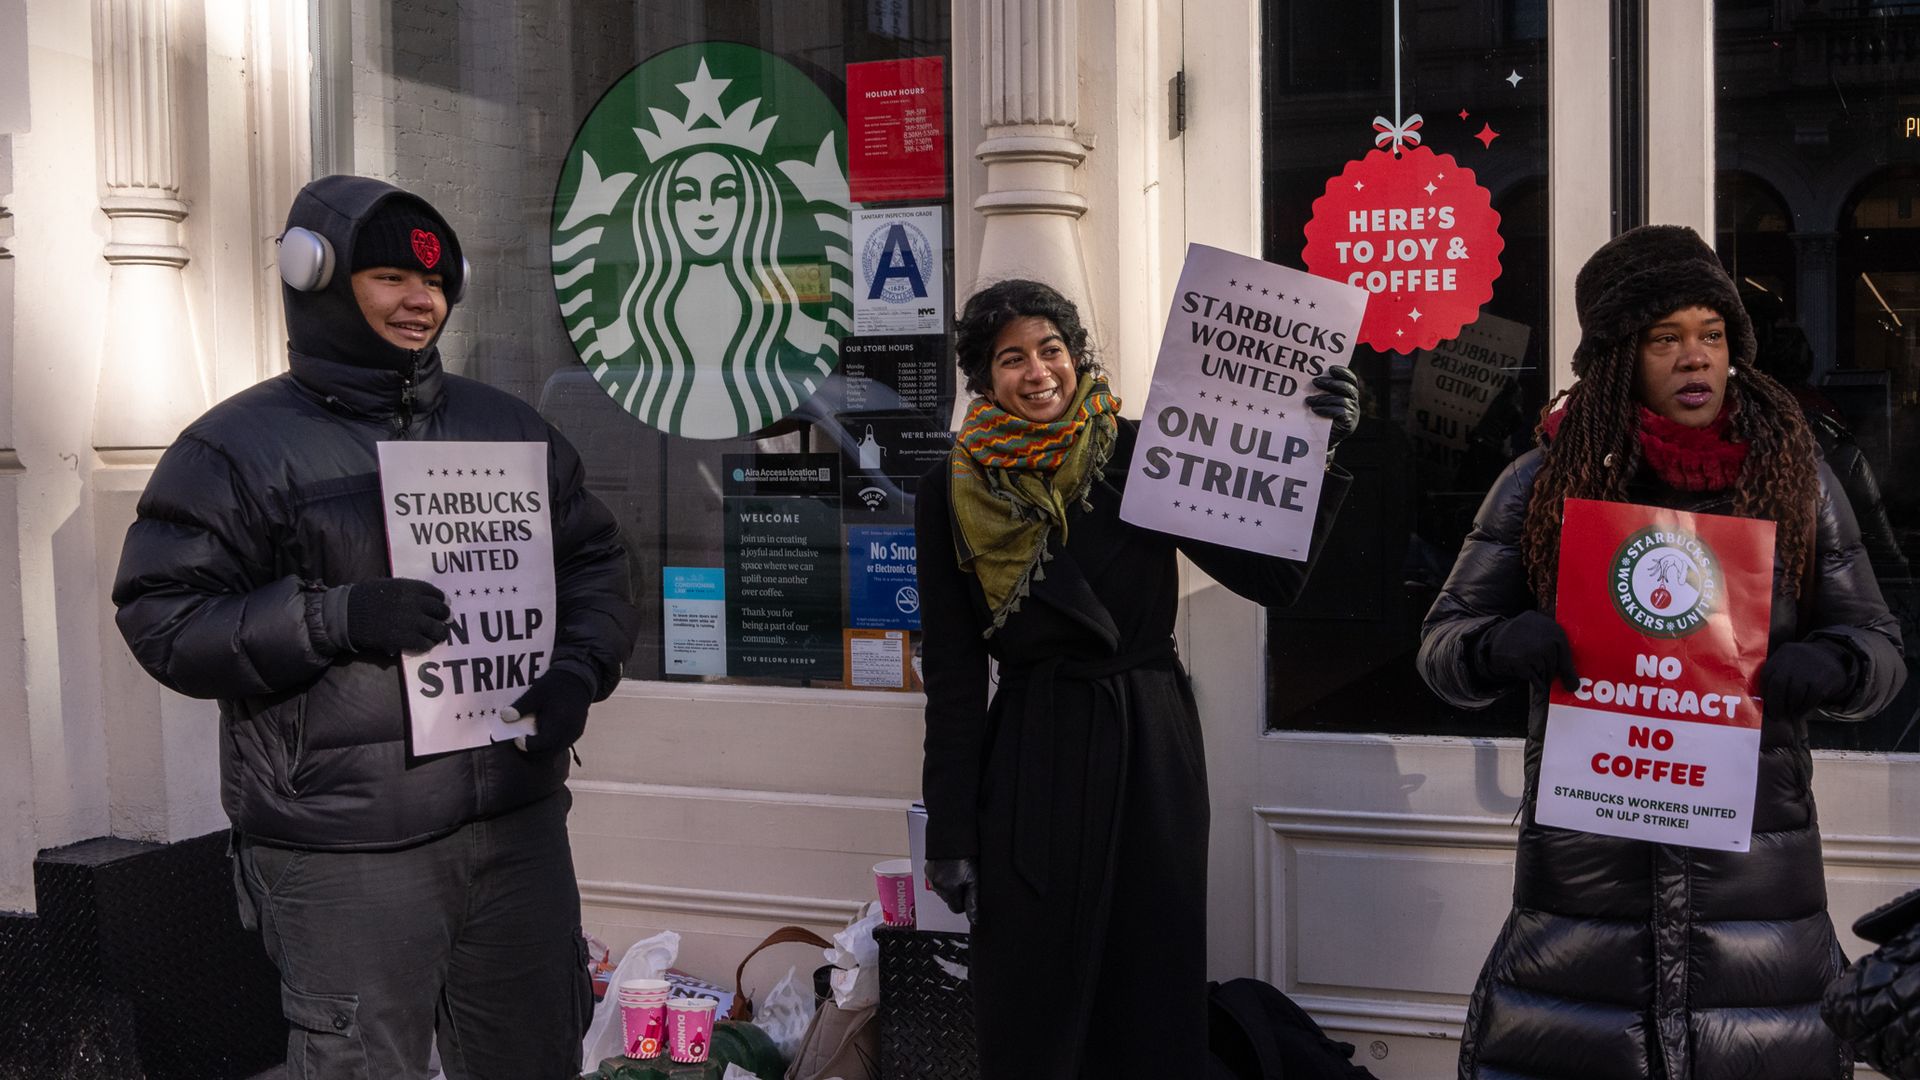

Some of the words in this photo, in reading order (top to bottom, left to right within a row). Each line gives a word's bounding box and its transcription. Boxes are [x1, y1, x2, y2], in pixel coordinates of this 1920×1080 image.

[865, 90, 898, 98] HOLIDAY
[899, 88, 924, 96] HOURS
[1348, 205, 1456, 233] HERE'S
[868, 224, 928, 300] A
[1335, 241, 1374, 264] TO
[1382, 237, 1437, 263] JOY
[1445, 236, 1470, 261] &
[1347, 268, 1458, 294] COFFEE
[1182, 291, 1346, 355] STARBUCKS
[846, 345, 862, 353] OUR
[864, 344, 887, 352] STORE
[888, 344, 914, 352] HOURS
[1190, 321, 1326, 376] WORKERS
[1200, 354, 1298, 398] UNITED
[900, 431, 924, 439] WE'RE
[926, 431, 952, 439] HIRING
[1157, 406, 1219, 447] ON
[1230, 423, 1310, 465] ULP
[745, 468, 759, 477] Aira
[760, 468, 787, 477] Access
[787, 468, 817, 477] location
[1142, 446, 1308, 512] STRIKE
[394, 491, 541, 516] STARBUCKS
[740, 513, 800, 524] WELCOME
[410, 520, 532, 545] WORKERS
[741, 535, 755, 544] Join
[756, 536, 766, 544] us
[776, 535, 807, 545] creating
[431, 548, 518, 574] UNITED
[746, 548, 768, 558] joyful
[768, 548, 783, 557] and
[784, 548, 818, 558] inclusive
[870, 542, 887, 560] No
[890, 542, 916, 560] Smo
[1626, 530, 1711, 567] STARBUCKS
[741, 563, 762, 572] space
[763, 562, 787, 570] where
[741, 575, 762, 584] uplift
[778, 575, 808, 584] another
[875, 564, 906, 574] Electronic
[906, 564, 916, 575] Cig
[759, 588, 784, 597] coffee.
[1617, 566, 1665, 632] WORKERS
[742, 608, 766, 617] Thank
[767, 610, 781, 618] you
[782, 608, 793, 617] for
[446, 611, 470, 646] N
[480, 608, 543, 644] ULP
[742, 621, 763, 631] being
[770, 622, 785, 632] part
[786, 622, 795, 630] of
[743, 634, 788, 646] community.
[760, 656, 788, 664] BELONG
[1635, 654, 1682, 681] NO
[417, 652, 544, 699] STRIKE
[1574, 678, 1742, 720] CONTRACT
[1628, 726, 1674, 752] NO
[1591, 752, 1707, 788] COFFEE
[1554, 786, 1624, 807] STARBUCKS
[1628, 796, 1690, 815] WORKERS
[1692, 805, 1737, 820] UNITED
[1596, 806, 1614, 819] ON
[1616, 809, 1640, 822] ULP
[1643, 812, 1690, 830] STRIKE!
[896, 880, 907, 919] DUNKIN'
[676, 1014, 686, 1055] DUNKIN'
